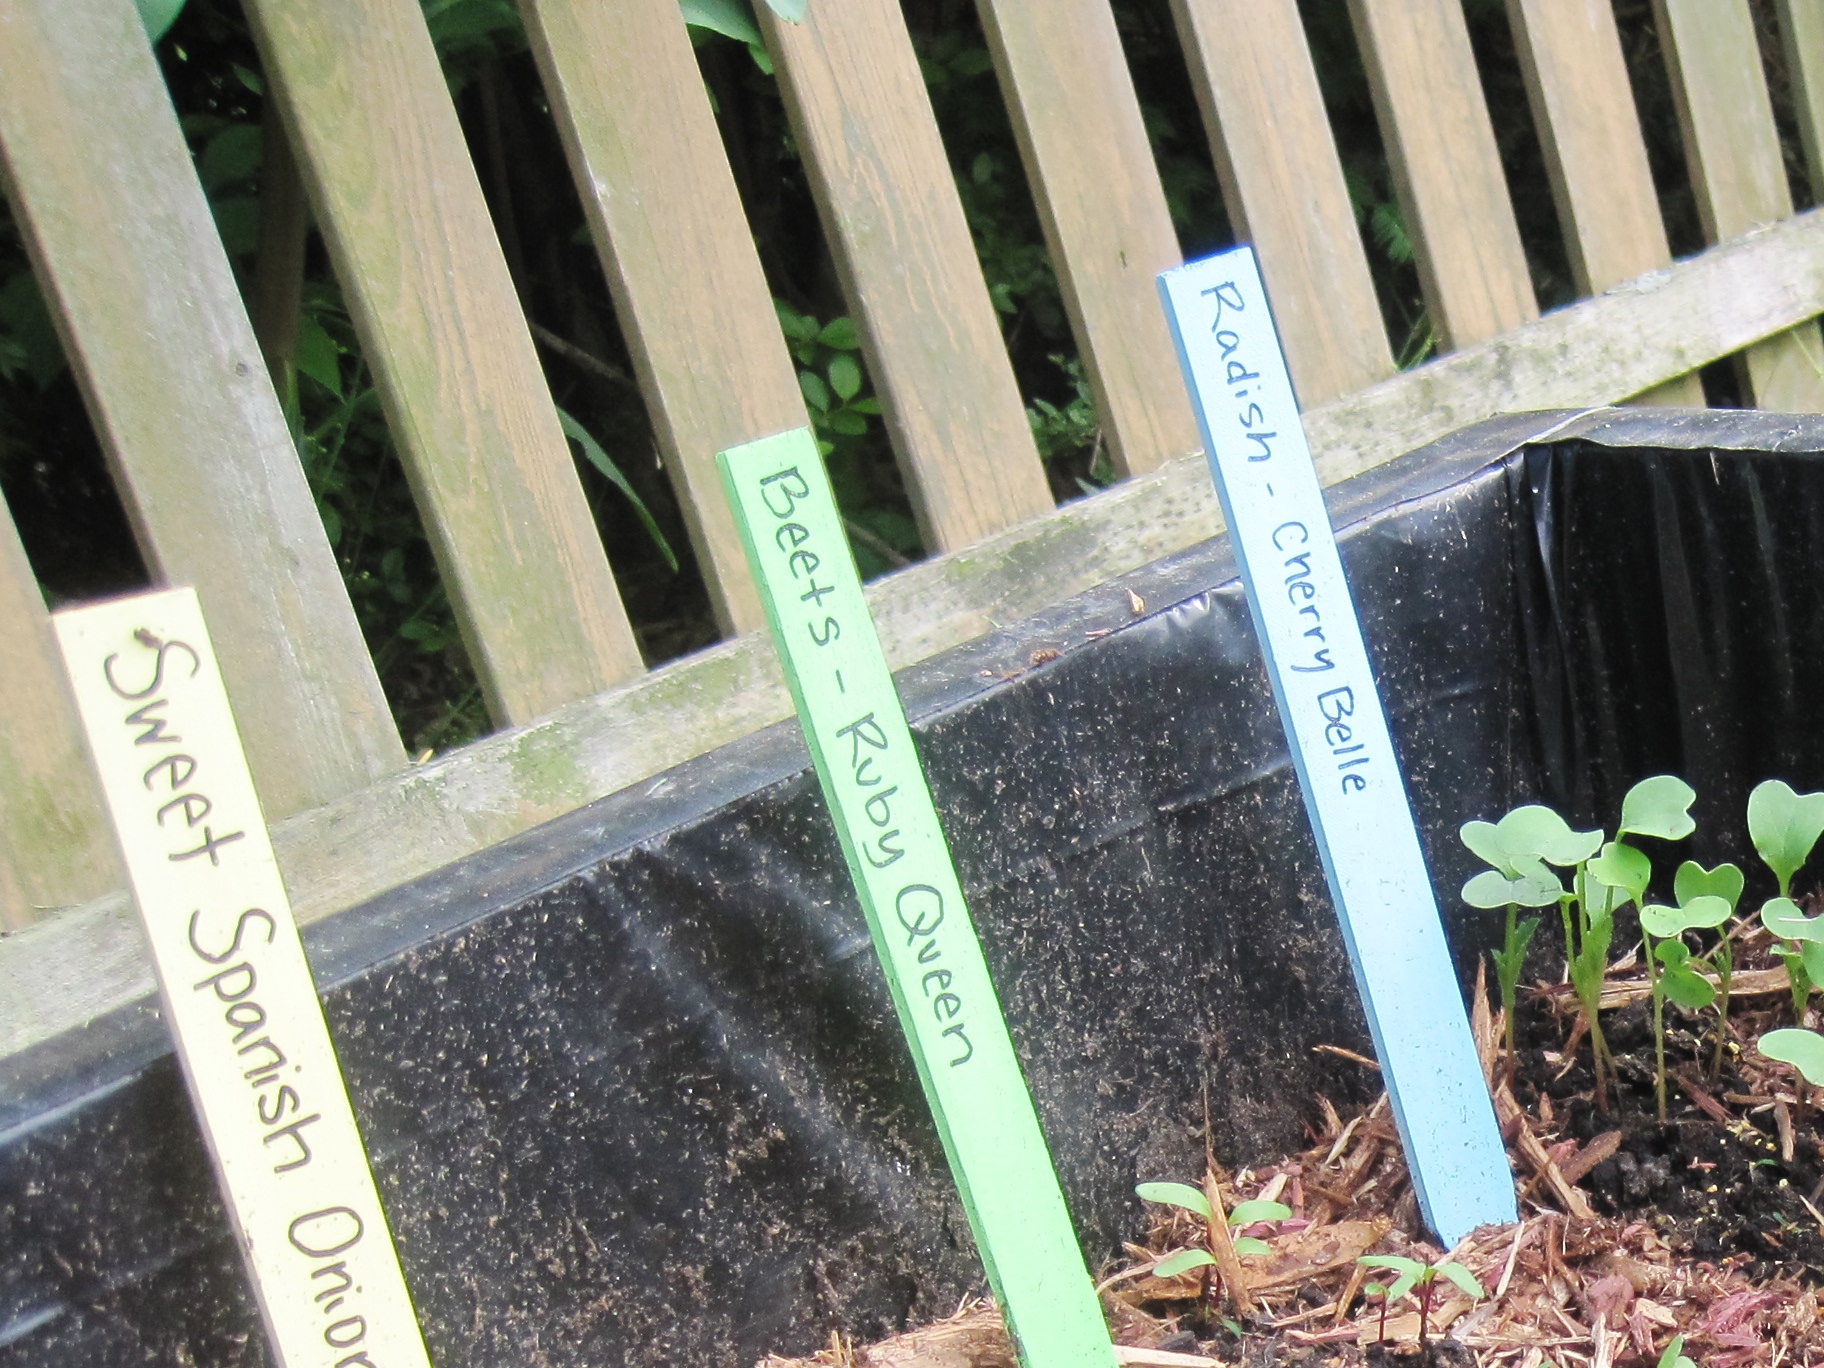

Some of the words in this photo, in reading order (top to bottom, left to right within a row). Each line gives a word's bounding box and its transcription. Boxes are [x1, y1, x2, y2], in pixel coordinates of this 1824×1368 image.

[759, 465, 840, 648] Beets
[835, 711, 906, 871] Ruby
[895, 882, 975, 1069] Queen
[1199, 280, 1278, 463] Radish
[1271, 519, 1337, 674] Cherry
[1316, 685, 1369, 796] Belle
[104, 628, 245, 868] Sweet
[189, 906, 320, 1175] Spanish
